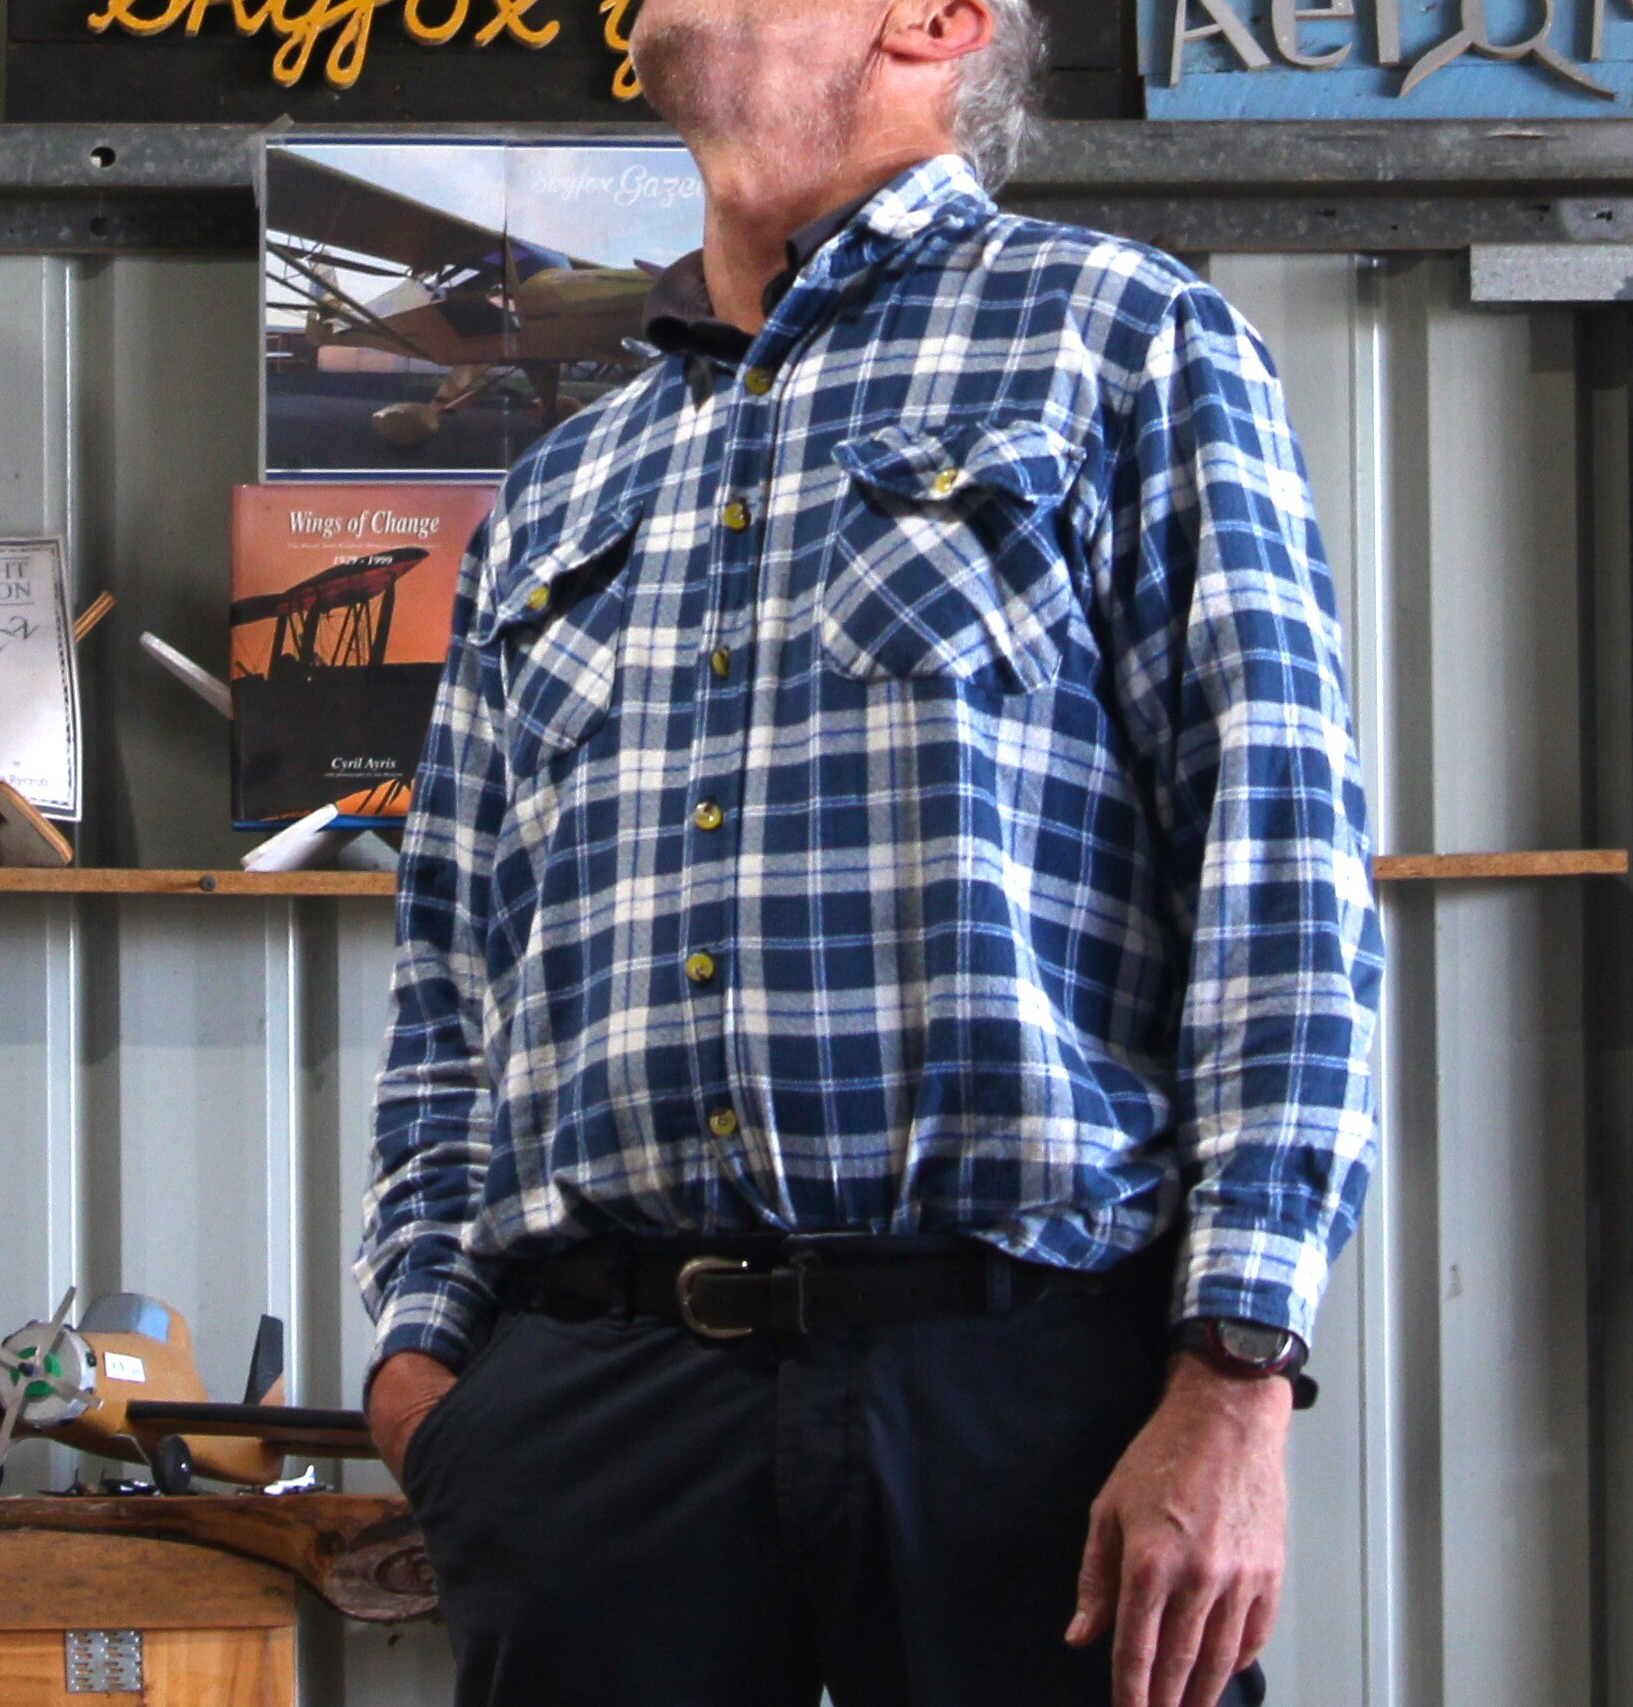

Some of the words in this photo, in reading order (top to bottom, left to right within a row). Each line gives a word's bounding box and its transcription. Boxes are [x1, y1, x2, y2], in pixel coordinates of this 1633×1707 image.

[289, 510, 343, 539] Wings
[347, 509, 369, 540] of
[371, 510, 440, 540] Change
[367, 555, 394, 565] 1999
[330, 756, 363, 772] Cyril
[364, 756, 397, 772] Ayris
